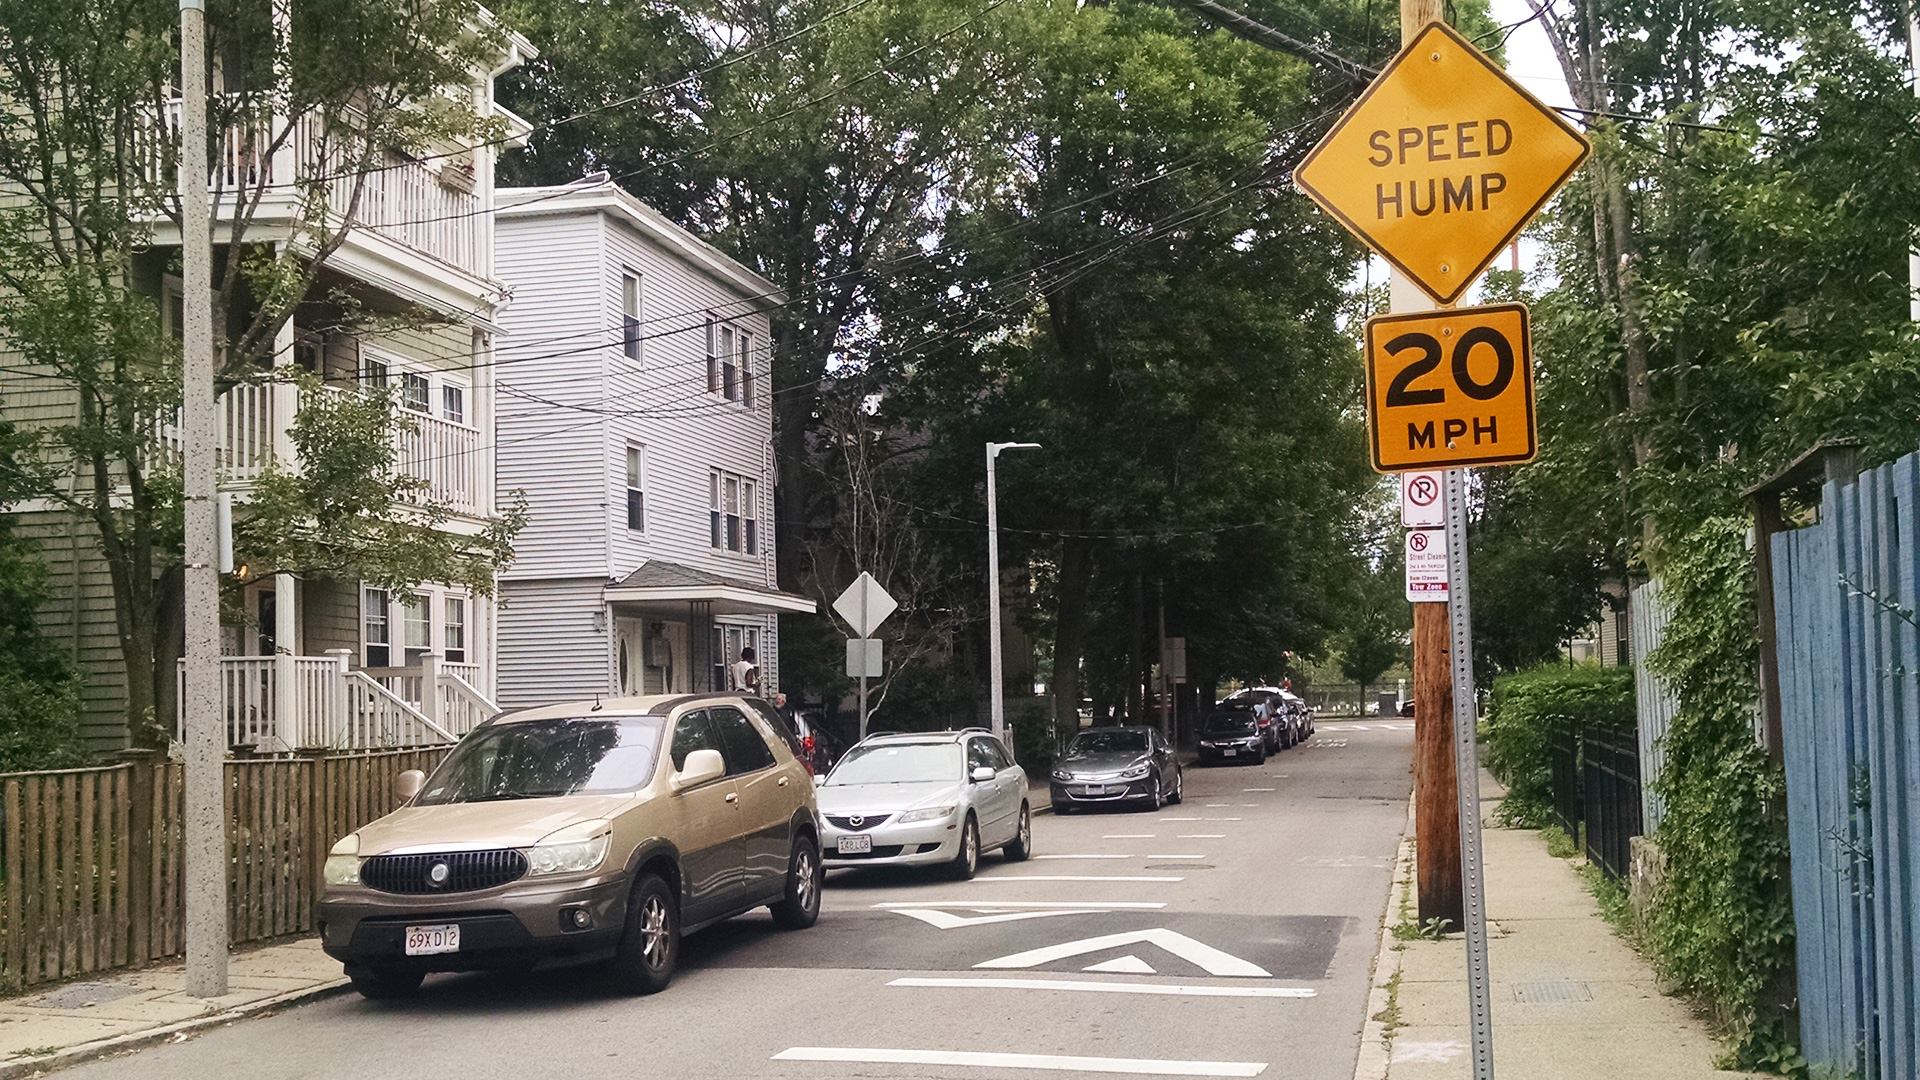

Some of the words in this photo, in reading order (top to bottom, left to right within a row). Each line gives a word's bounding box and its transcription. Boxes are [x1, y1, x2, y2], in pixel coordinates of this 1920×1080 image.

[1368, 119, 1513, 168] SPEED
[1376, 173, 1507, 220] HUMP
[1383, 326, 1515, 408] 20
[1407, 416, 1498, 451] MPH
[1409, 553, 1426, 561] Street
[1427, 553, 1447, 561] Cleanin
[409, 932, 431, 948] 69X
